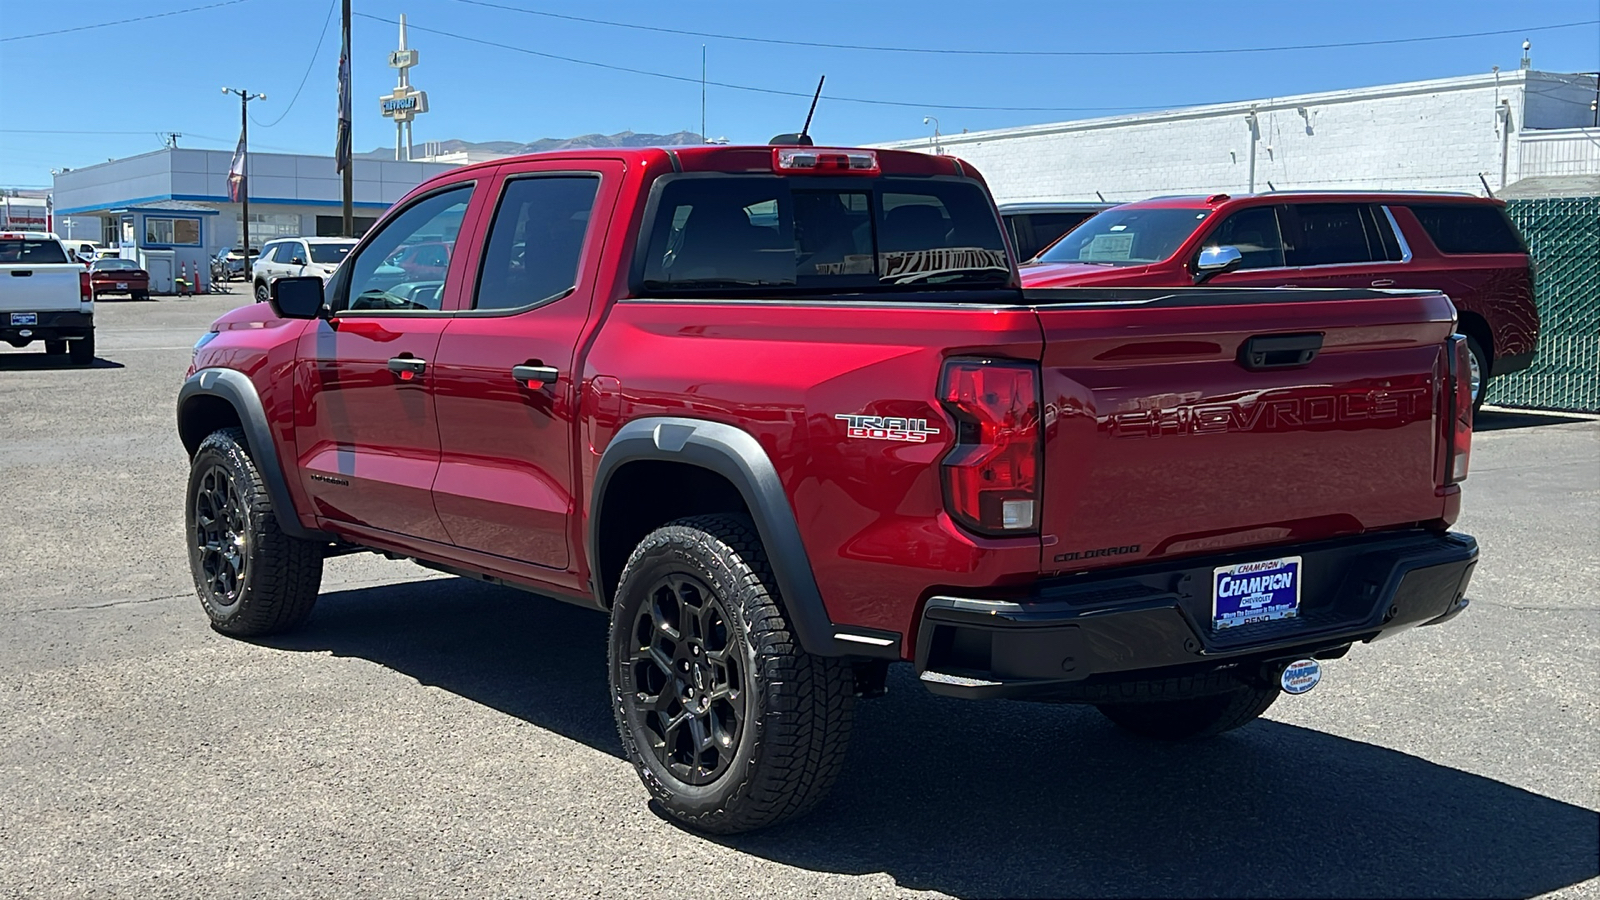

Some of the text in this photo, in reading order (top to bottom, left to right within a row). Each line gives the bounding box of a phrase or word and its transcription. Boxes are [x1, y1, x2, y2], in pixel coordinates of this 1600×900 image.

[1108, 387, 1427, 439] CHEVROLET
[835, 413, 940, 433] TRAIL
[847, 428, 927, 443] BOSS
[1053, 545, 1141, 562] COLORADO
[1238, 561, 1279, 573] CHAMPION
[1218, 572, 1293, 598] CHAMPION
[1241, 595, 1271, 605] CHEVROLET
